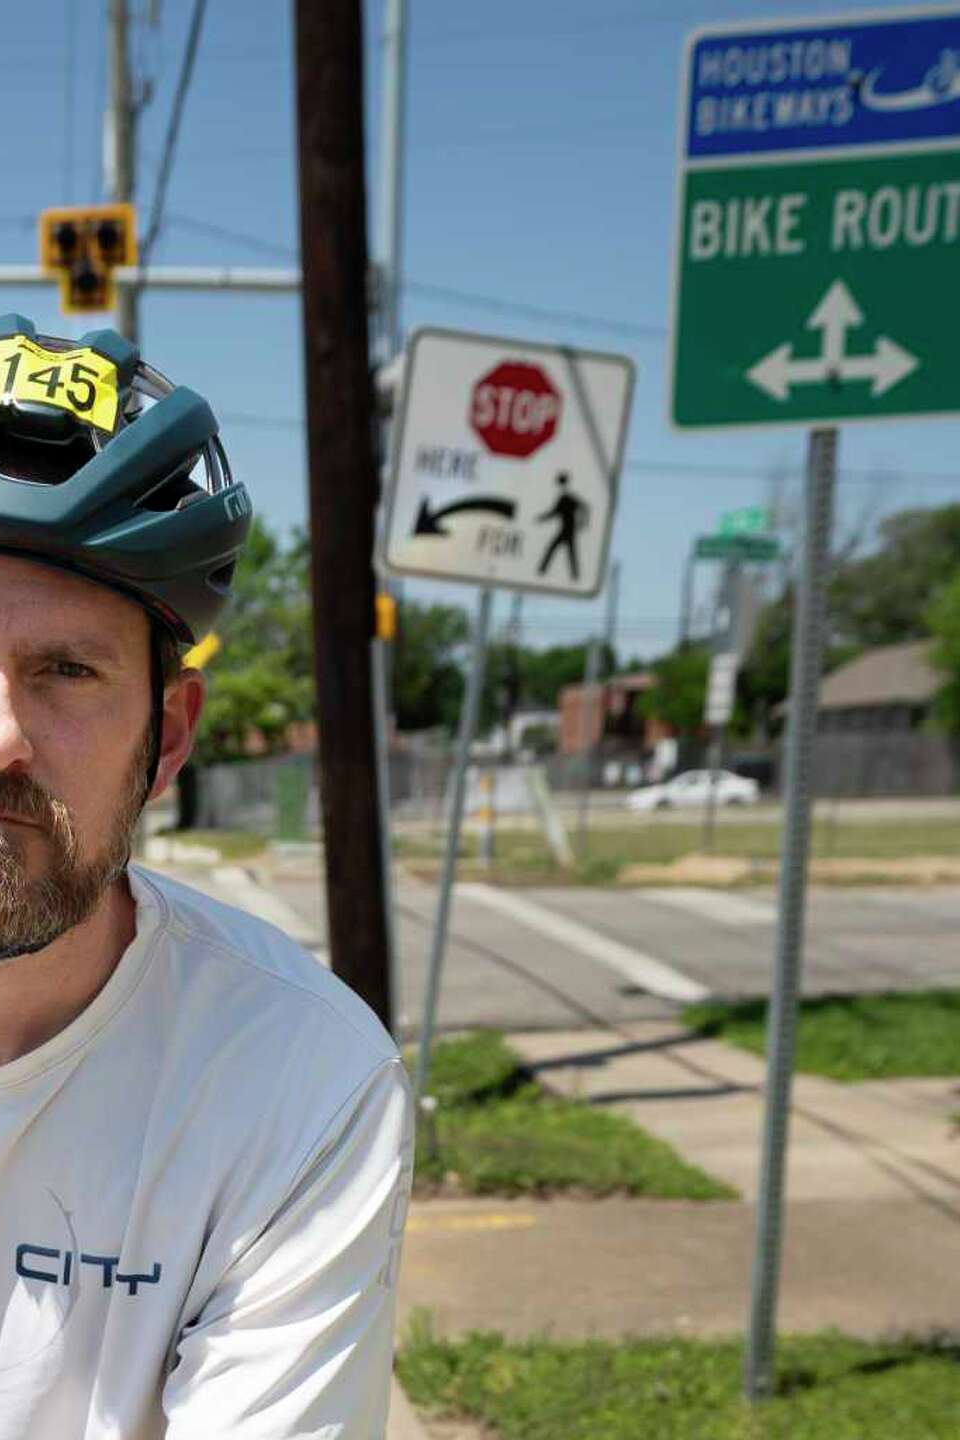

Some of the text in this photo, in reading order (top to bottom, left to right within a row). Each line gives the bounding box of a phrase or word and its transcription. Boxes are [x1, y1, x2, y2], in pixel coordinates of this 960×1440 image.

[697, 39, 851, 86] HOUSTON
[695, 87, 854, 136] BIKEWAYS
[690, 194, 807, 260] BIKE
[4, 352, 99, 412] 145
[473, 385, 557, 435] STOP
[15, 1243, 162, 1296] CITY
